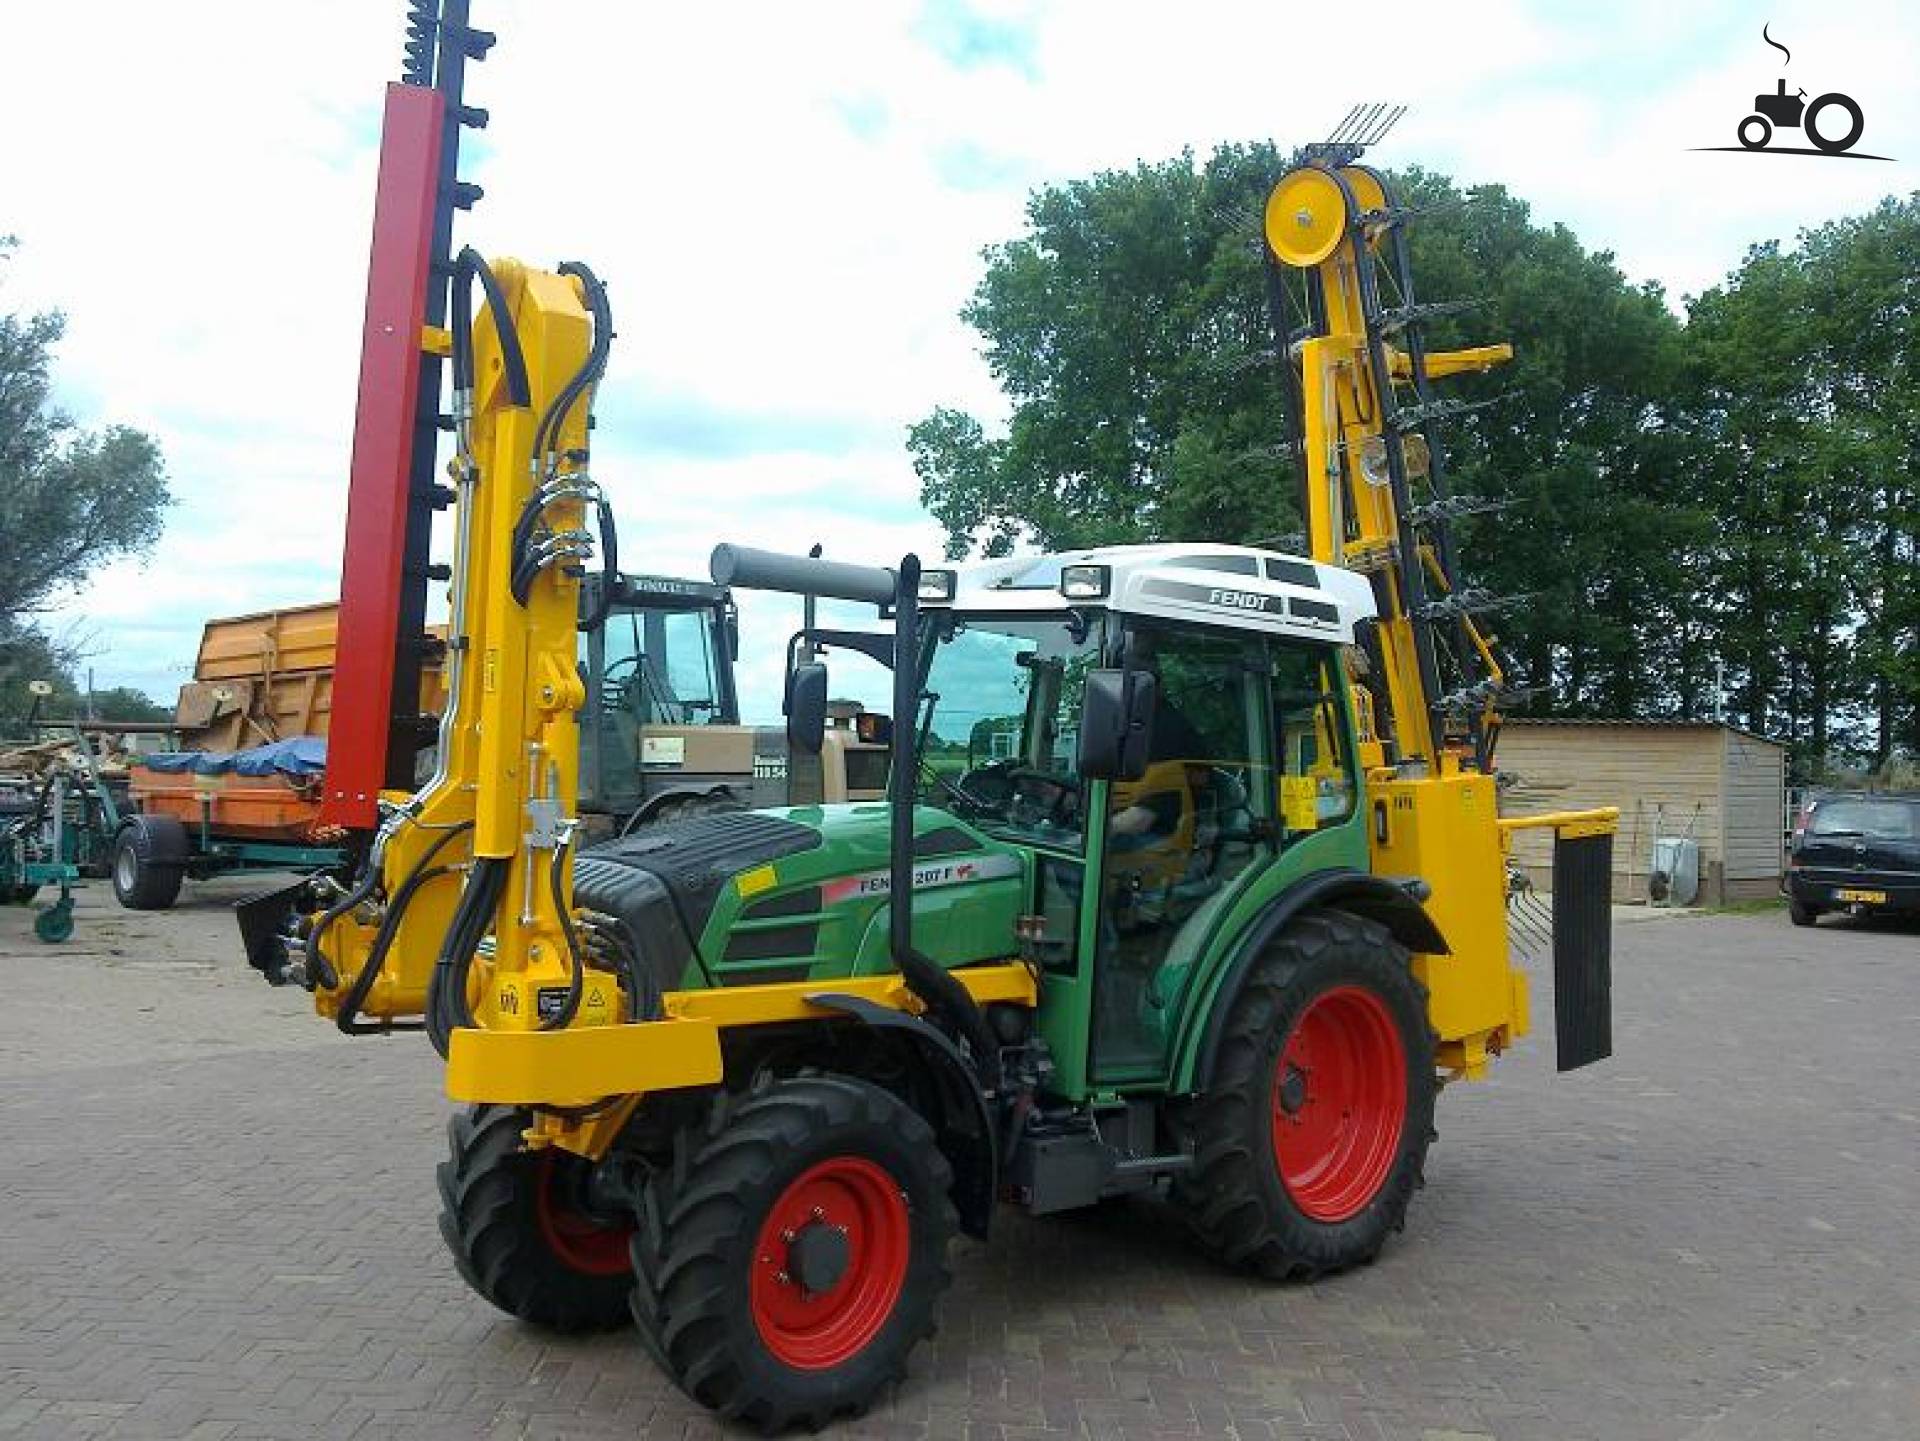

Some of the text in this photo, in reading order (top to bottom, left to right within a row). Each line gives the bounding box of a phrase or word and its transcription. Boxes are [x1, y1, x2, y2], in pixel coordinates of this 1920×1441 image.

[1208, 589, 1269, 610] FENDT
[860, 865, 953, 894] FEN 207 F
